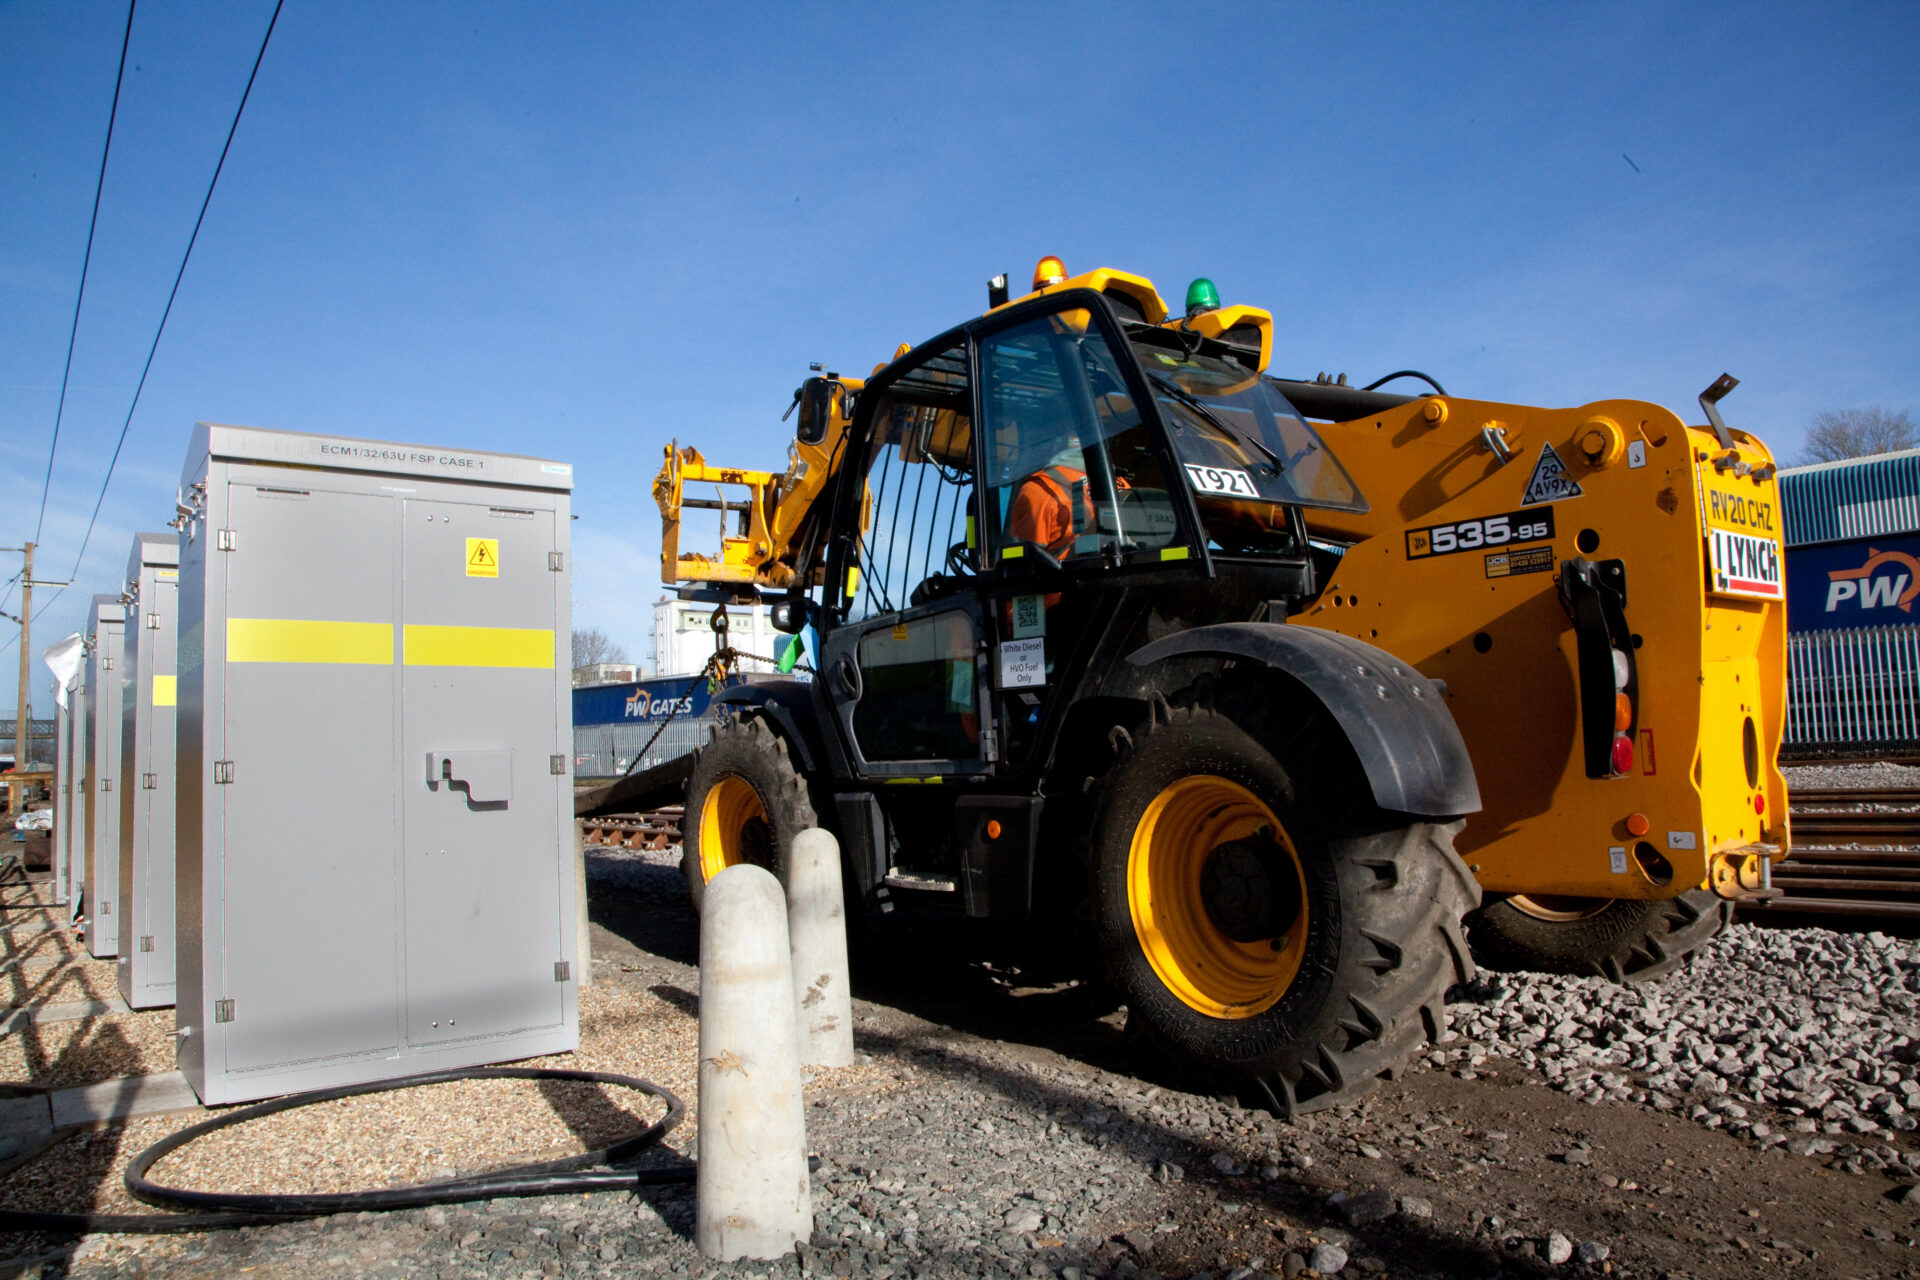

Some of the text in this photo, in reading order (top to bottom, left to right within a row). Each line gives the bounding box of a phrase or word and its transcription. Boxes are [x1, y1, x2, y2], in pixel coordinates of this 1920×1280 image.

[321, 444, 484, 469] ECM1/32/63U FSP CASE 1
[1186, 467, 1256, 495] T921
[1542, 464, 1558, 480] 29
[1710, 489, 1773, 531] RV20 CHZ
[1413, 516, 1548, 553] JCB 535-95
[1488, 556, 1507, 565] JCB
[1727, 534, 1779, 582] LYNCH
[1825, 574, 1909, 612] PW
[1004, 641, 1042, 653] White Diesel
[1010, 663, 1038, 673] HVO Fuel
[1017, 674, 1032, 684] Only
[625, 701, 647, 717] PW
[650, 697, 693, 716] GATES
